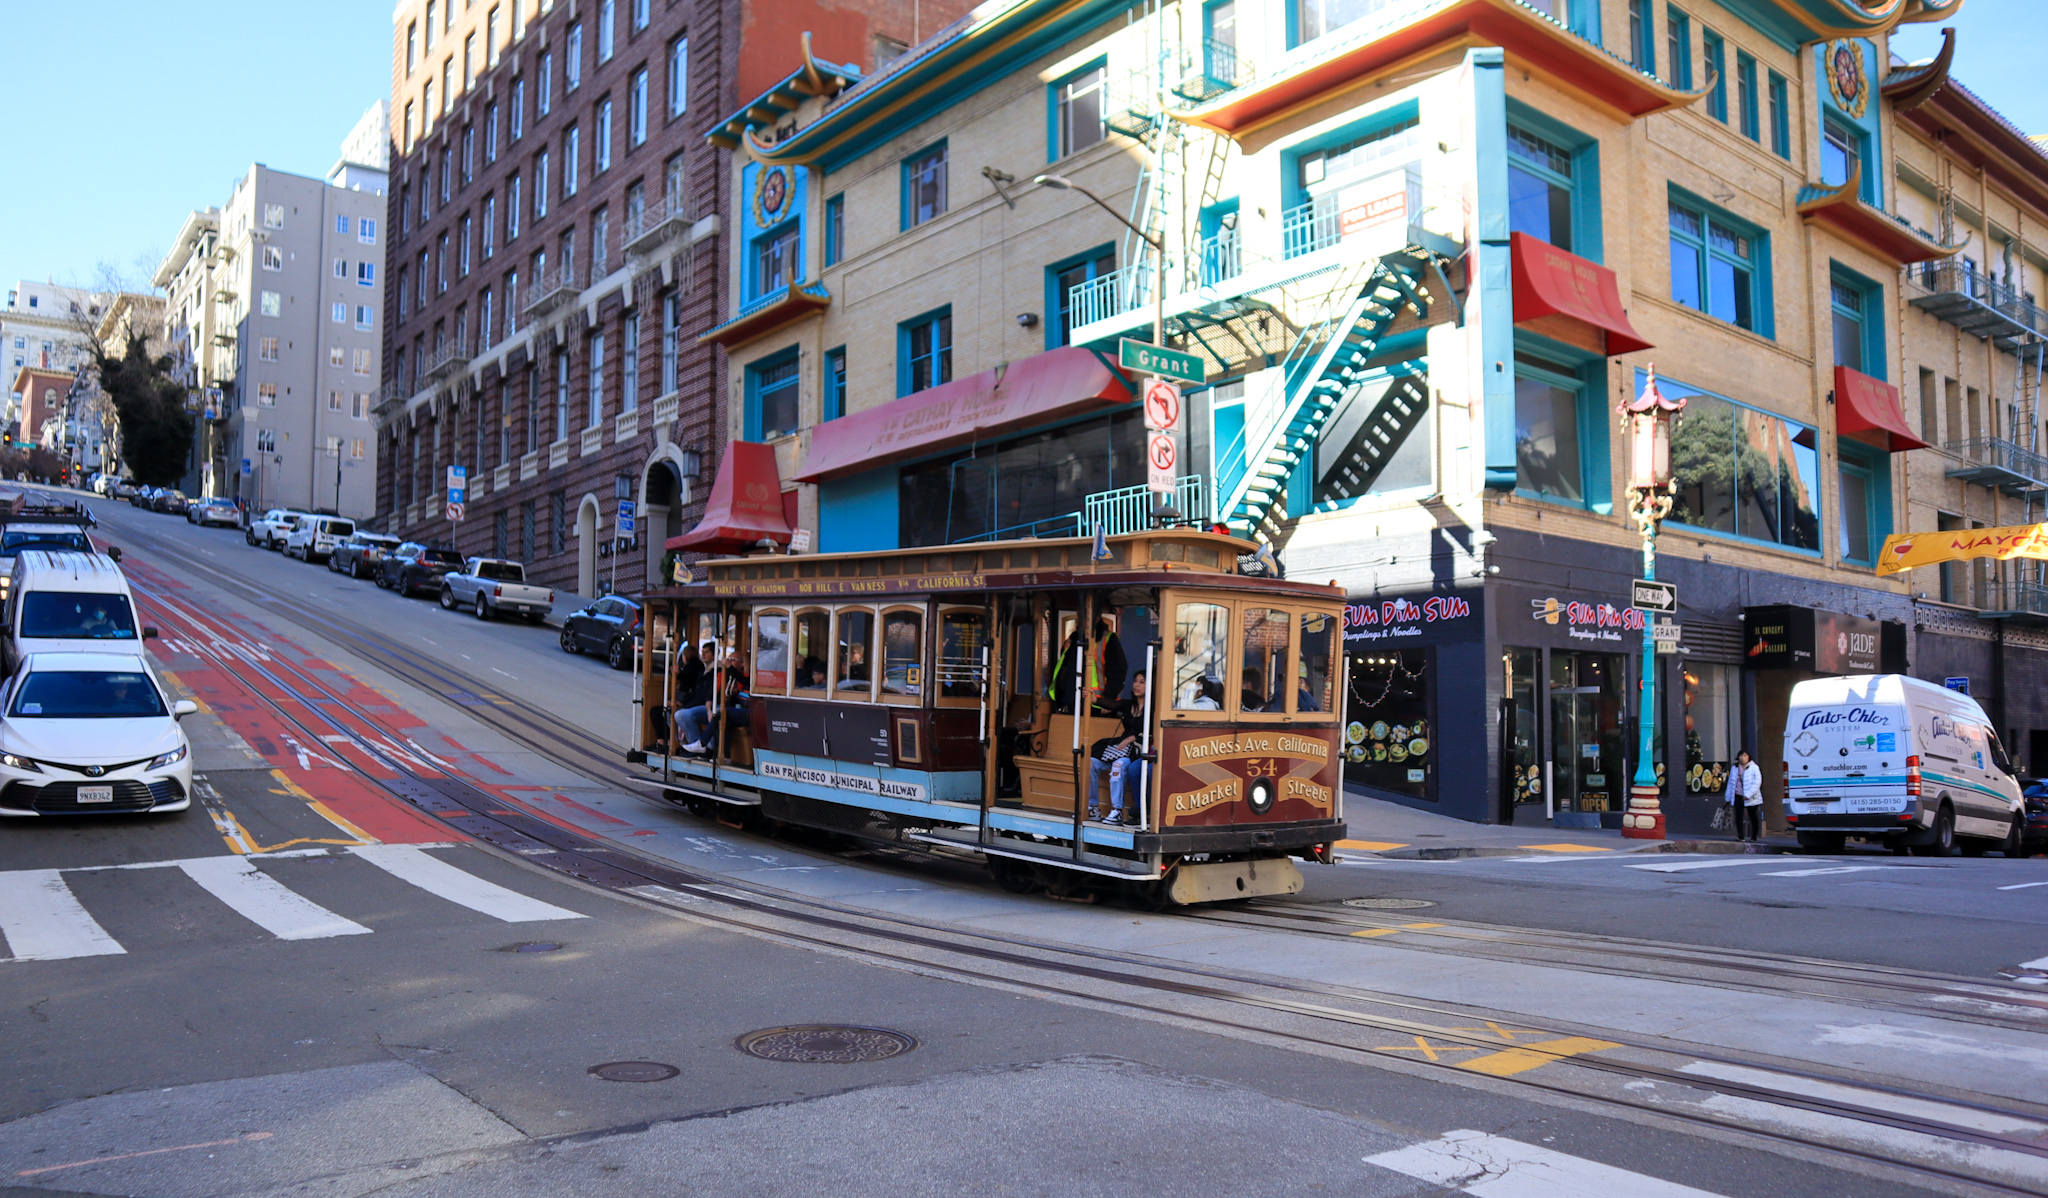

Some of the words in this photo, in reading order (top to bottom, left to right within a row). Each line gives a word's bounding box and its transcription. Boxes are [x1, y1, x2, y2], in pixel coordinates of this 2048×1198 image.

[1139, 350, 1189, 374] Grant
[903, 398, 956, 429] CATHAY
[1151, 473, 1160, 483] ON
[1162, 474, 1175, 486] RED
[715, 585, 736, 594] MARKET
[752, 583, 786, 594] CHINATOWN
[799, 583, 812, 592] NOB
[816, 583, 832, 592] HILL
[851, 582, 865, 592] VAN
[867, 581, 886, 591] NESS
[917, 577, 970, 589] CALIFORNIA
[1637, 588, 1649, 601] ONE
[1651, 591, 1664, 602] WAY
[1424, 596, 1470, 622] SUM
[1567, 601, 1596, 625] SUM
[1343, 629, 1381, 641] Dumplings
[1382, 629, 1388, 638] &
[1390, 626, 1422, 637] Noodles
[1569, 627, 1596, 641] Dumplings
[1602, 630, 1622, 641] Noodles
[1655, 627, 1679, 638] GRANT
[1802, 708, 1889, 730] Auto-Chlor
[1184, 743, 1208, 759] Van
[1209, 739, 1241, 756] Ness
[1277, 737, 1328, 758] California
[1246, 758, 1278, 777] 54
[1823, 764, 1868, 772] autochlor.com
[765, 764, 780, 775] SAN
[782, 767, 827, 783] FRANCISCO
[830, 775, 874, 791] MUNICIPAL
[880, 783, 918, 797] RAILWAY
[1175, 794, 1187, 811] &
[1188, 781, 1238, 810] Market
[1287, 779, 1328, 803] Streets
[1583, 799, 1608, 811] OPEN
